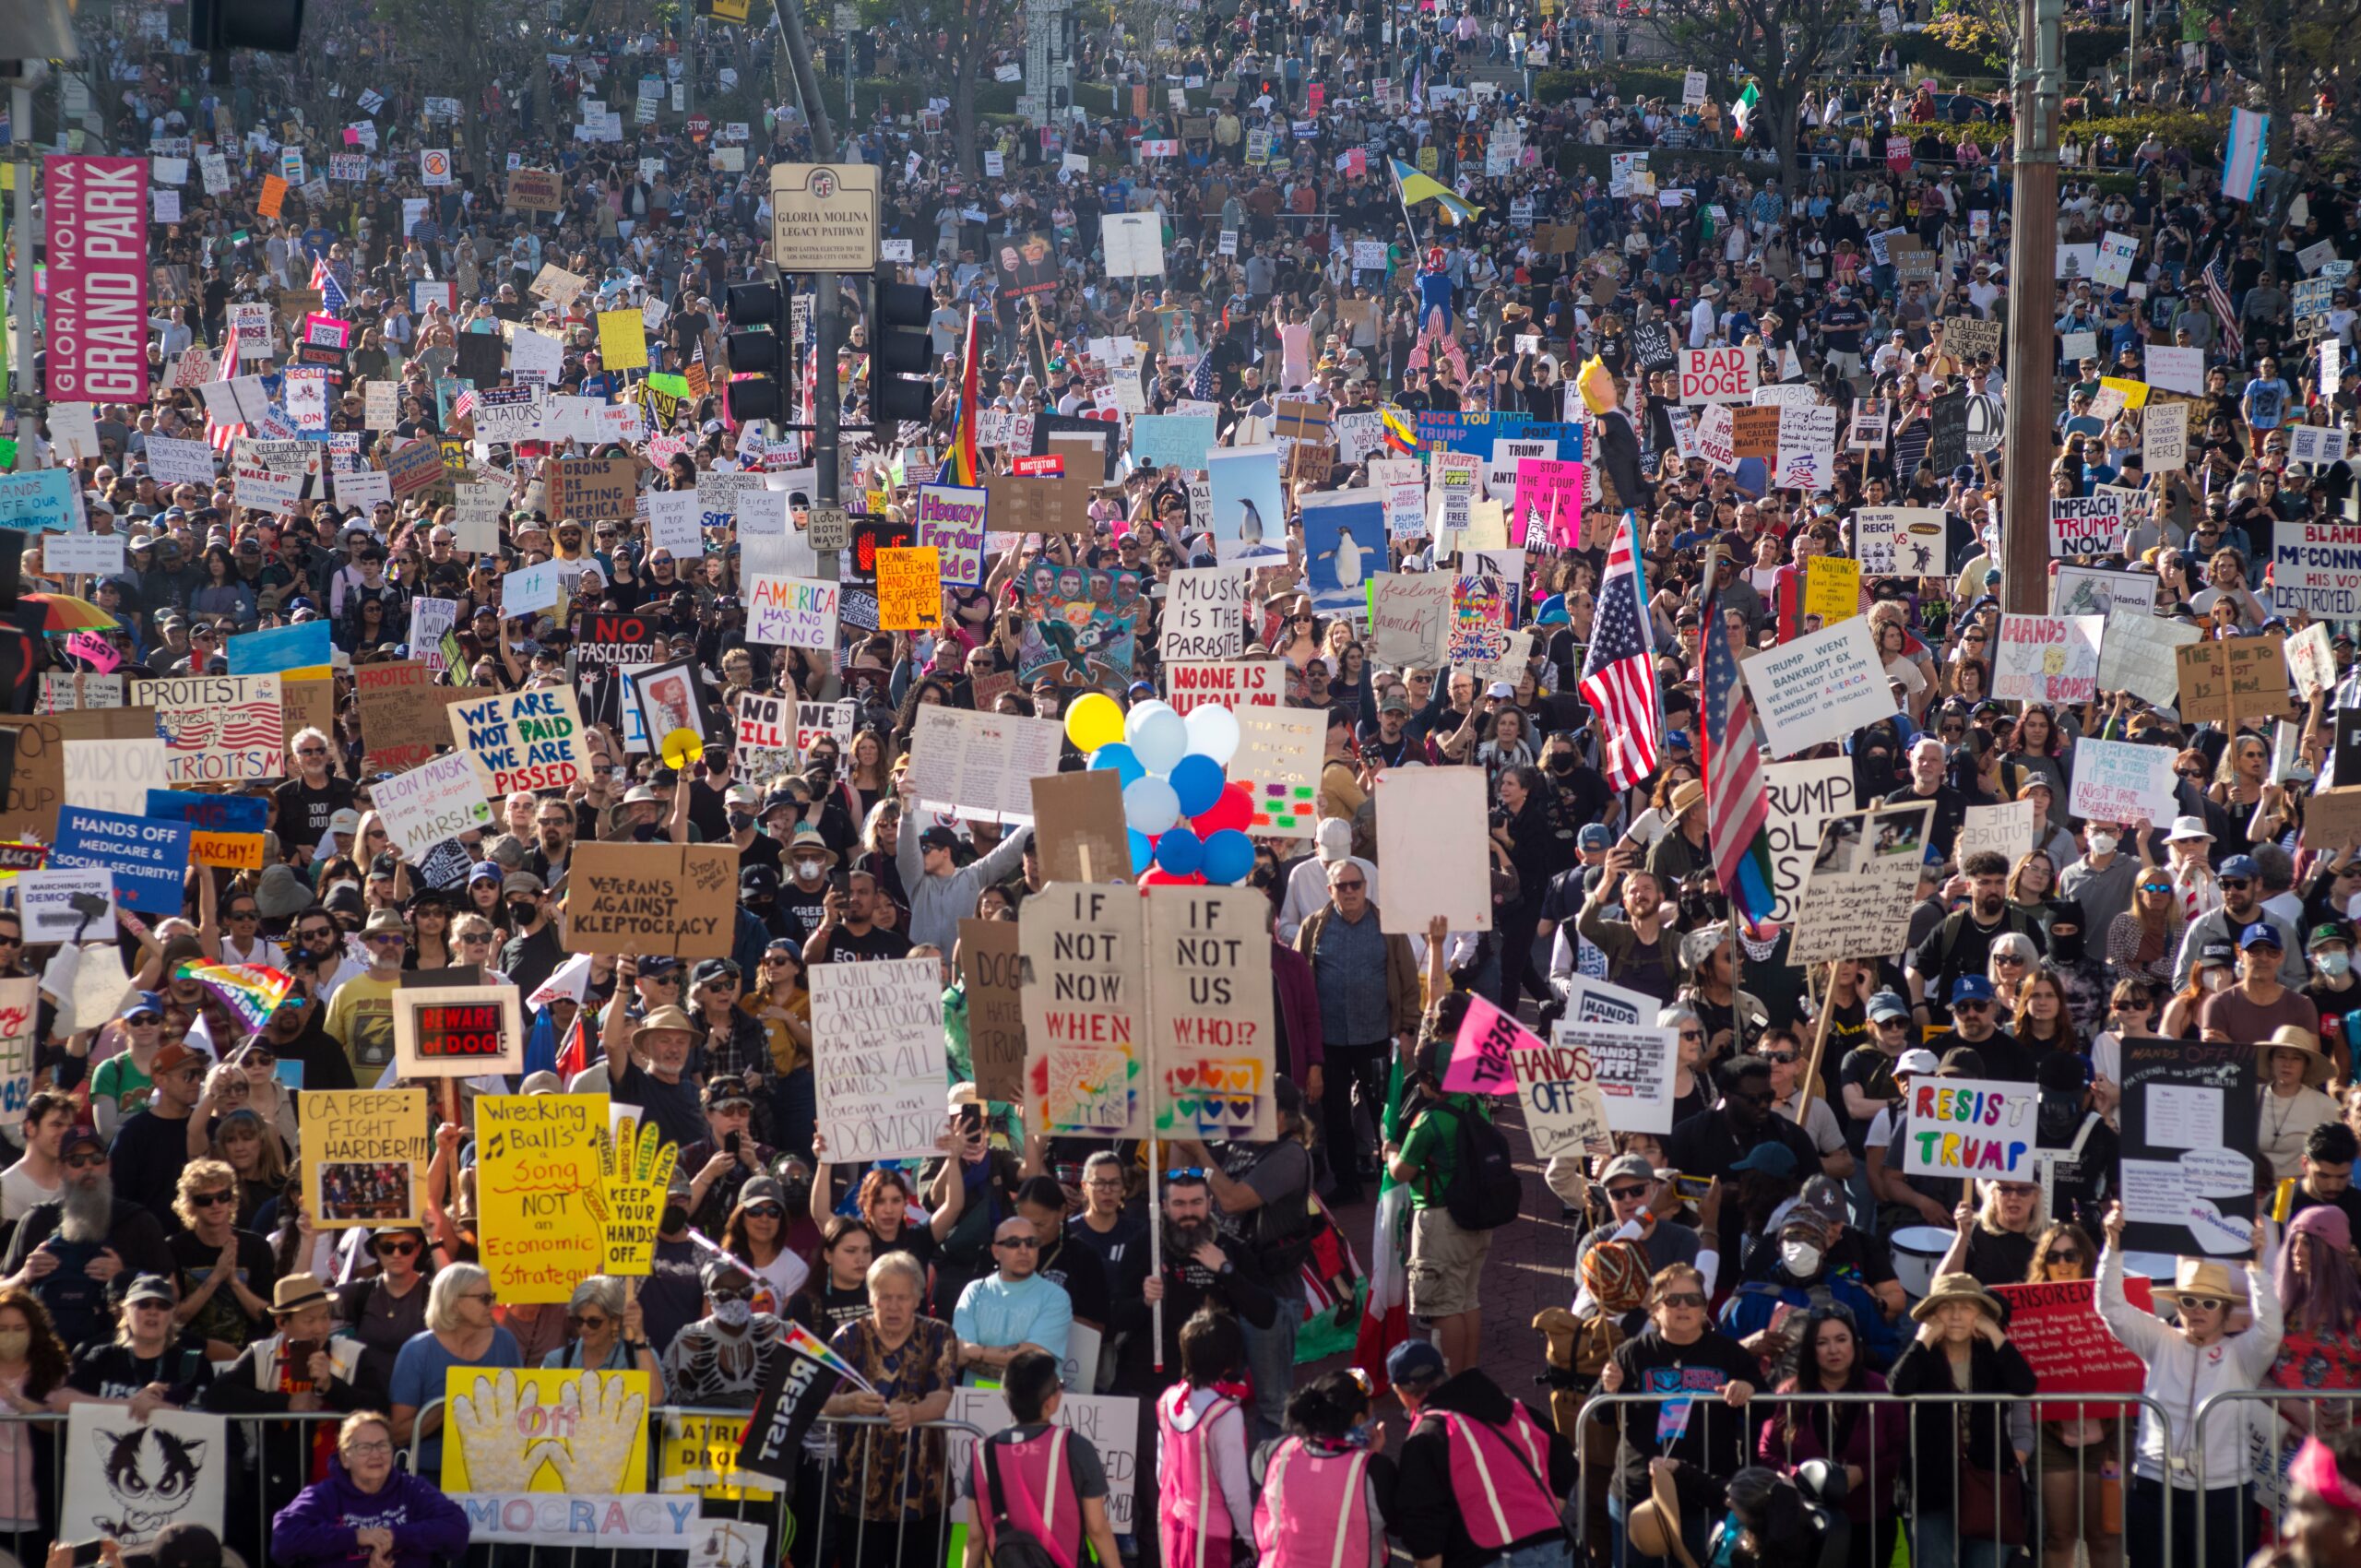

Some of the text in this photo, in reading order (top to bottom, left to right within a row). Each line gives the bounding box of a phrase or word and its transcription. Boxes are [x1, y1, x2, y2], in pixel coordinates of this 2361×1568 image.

[687, 120, 710, 130] STOP
[1295, 129, 1319, 137] TRUMP
[1888, 147, 1911, 159] OFF!
[777, 211, 868, 222] GLORIA MOLINA
[782, 227, 865, 236] LEGACY PATHWAY
[55, 162, 76, 391] GLORIA MOLINA
[85, 164, 138, 394] GRAND PARK
[1898, 267, 1934, 277] FUTURE
[1634, 326, 1655, 340] NO
[1947, 317, 1999, 334] COLLECTIVE
[1951, 329, 1998, 343] LIBERATION
[1635, 337, 1668, 356] MORE
[184, 351, 203, 362] NO
[303, 350, 340, 363] RESIST
[1639, 346, 1672, 367] KINGS
[1692, 348, 1745, 372] BAD
[176, 363, 209, 374] TURD
[286, 369, 325, 380] RECALL
[174, 375, 208, 387] REICH
[1683, 370, 1751, 398] DOGE
[1756, 386, 1816, 406] FUCK
[474, 403, 542, 422] DICTATORS
[604, 409, 626, 420] HANDS
[1420, 411, 1490, 426] FUCK YOU
[2154, 418, 2176, 427] CORY
[492, 431, 525, 440] AMERICA
[1419, 428, 1467, 441] TRUMP
[2152, 435, 2178, 444] SPEECH
[150, 447, 205, 460] DEMOCRACY
[765, 451, 799, 463] MEASLES
[1509, 445, 1544, 457] TRUMP
[2324, 443, 2342, 452] FREE
[551, 461, 611, 477] MORONS
[1020, 459, 1057, 471] DICTATOR
[1438, 454, 1478, 466] TARIFFS
[1541, 463, 1564, 472] STOP
[1784, 453, 1819, 488] 愛
[464, 484, 488, 495] IKEA
[552, 477, 582, 492] ARE
[1445, 477, 1470, 485] OFF!
[1523, 476, 1575, 488] THE COUP
[32, 496, 58, 509] OUR
[552, 489, 623, 507] GUTTING
[656, 501, 685, 513] DEPORT
[2052, 496, 2118, 518] IMPEACH
[664, 515, 684, 524] MUSK
[813, 515, 843, 524] LOOK
[922, 493, 984, 529] Hooray
[1395, 515, 1421, 523] DUMP
[1876, 514, 1894, 522] TURD
[813, 525, 843, 535] BOTH
[1393, 521, 1424, 530] TRUMP
[1394, 530, 1422, 540] ASAP!
[1863, 523, 1895, 533] REICH
[2054, 516, 2119, 538] TRUMP
[813, 535, 843, 545] WAYS
[922, 524, 984, 550] For Our
[1893, 533, 1908, 545] VS
[880, 563, 901, 575] TELL
[877, 574, 939, 588] HANDS OFF!
[1178, 576, 1241, 600] MUSK
[753, 579, 836, 615] AMERICA
[880, 588, 940, 601] HE GRABBED
[2114, 593, 2147, 607] Hands
[2276, 586, 2352, 612] DESTROYED
[890, 600, 930, 612] YOU BY
[764, 608, 822, 626] HAS NO
[884, 612, 911, 625] YOUR
[596, 618, 645, 643] NO
[757, 623, 825, 645] KING
[1464, 634, 1483, 645] OUR
[2001, 617, 2067, 644] HANDS
[577, 642, 654, 664] FASCISTS!
[1166, 632, 1241, 659] PARASITE
[1448, 647, 1498, 660] SCHOOLS
[1764, 636, 1849, 676] TRUMP WENT
[359, 663, 426, 690] PROTECT
[1772, 651, 1852, 689] BANKRUPT 6X
[138, 677, 271, 704] PROTEST is
[1766, 659, 1868, 705] WE WILL NOT LET HIM
[255, 688, 273, 699] the
[1772, 672, 1868, 717] BANKRUPT AMERICA
[458, 693, 565, 726] WE ARE
[742, 696, 777, 723] NO
[469, 716, 574, 750] NOT PAID
[480, 741, 575, 771] WE ARE
[375, 755, 469, 809] ELON MUSK
[494, 763, 577, 794] PISSED
[72, 816, 177, 844] HANDS OFF
[407, 805, 472, 847] MARS!
[78, 837, 163, 860] MEDICARE &
[56, 852, 179, 881] SOCIAL SECURITY!
[688, 858, 718, 877] STOP
[30, 881, 101, 892] MARCHING FOR
[588, 876, 675, 897] VETERANS
[591, 897, 679, 918] AGAINST
[1074, 891, 1103, 921] IF
[1190, 899, 1222, 930] IF
[573, 913, 719, 936] KLEPTOCRACY
[1053, 932, 1120, 961] NOT
[1177, 938, 1242, 968] NOT
[1054, 972, 1124, 1004] NOW
[1190, 976, 1232, 1005] US
[423, 1006, 496, 1028] BEWARE
[1584, 999, 1635, 1024] HANDS
[1045, 1011, 1132, 1043] WHEN
[423, 1032, 507, 1055] of DOGE
[1508, 1046, 1593, 1084] HANDS
[2202, 1075, 2238, 1087] HEALTH
[307, 1094, 410, 1119] CA REPS:
[1532, 1080, 1576, 1115] OFF
[1916, 1085, 2031, 1128] RESIST
[481, 1100, 587, 1133] Wrecking
[328, 1120, 396, 1139] FIGHT
[510, 1126, 575, 1149] Ball's
[325, 1136, 425, 1161] HARDER!!!
[1914, 1131, 2027, 1172] TRUMP
[513, 1159, 578, 1186] Song
[522, 1192, 570, 1218] NOT
[610, 1188, 650, 1203] KEEP
[616, 1204, 655, 1221] YOUR
[535, 1219, 553, 1231] an
[606, 1225, 655, 1243] HANDS
[486, 1234, 595, 1258] Economic
[609, 1245, 647, 1263] OFF...
[516, 1406, 580, 1441] Off
